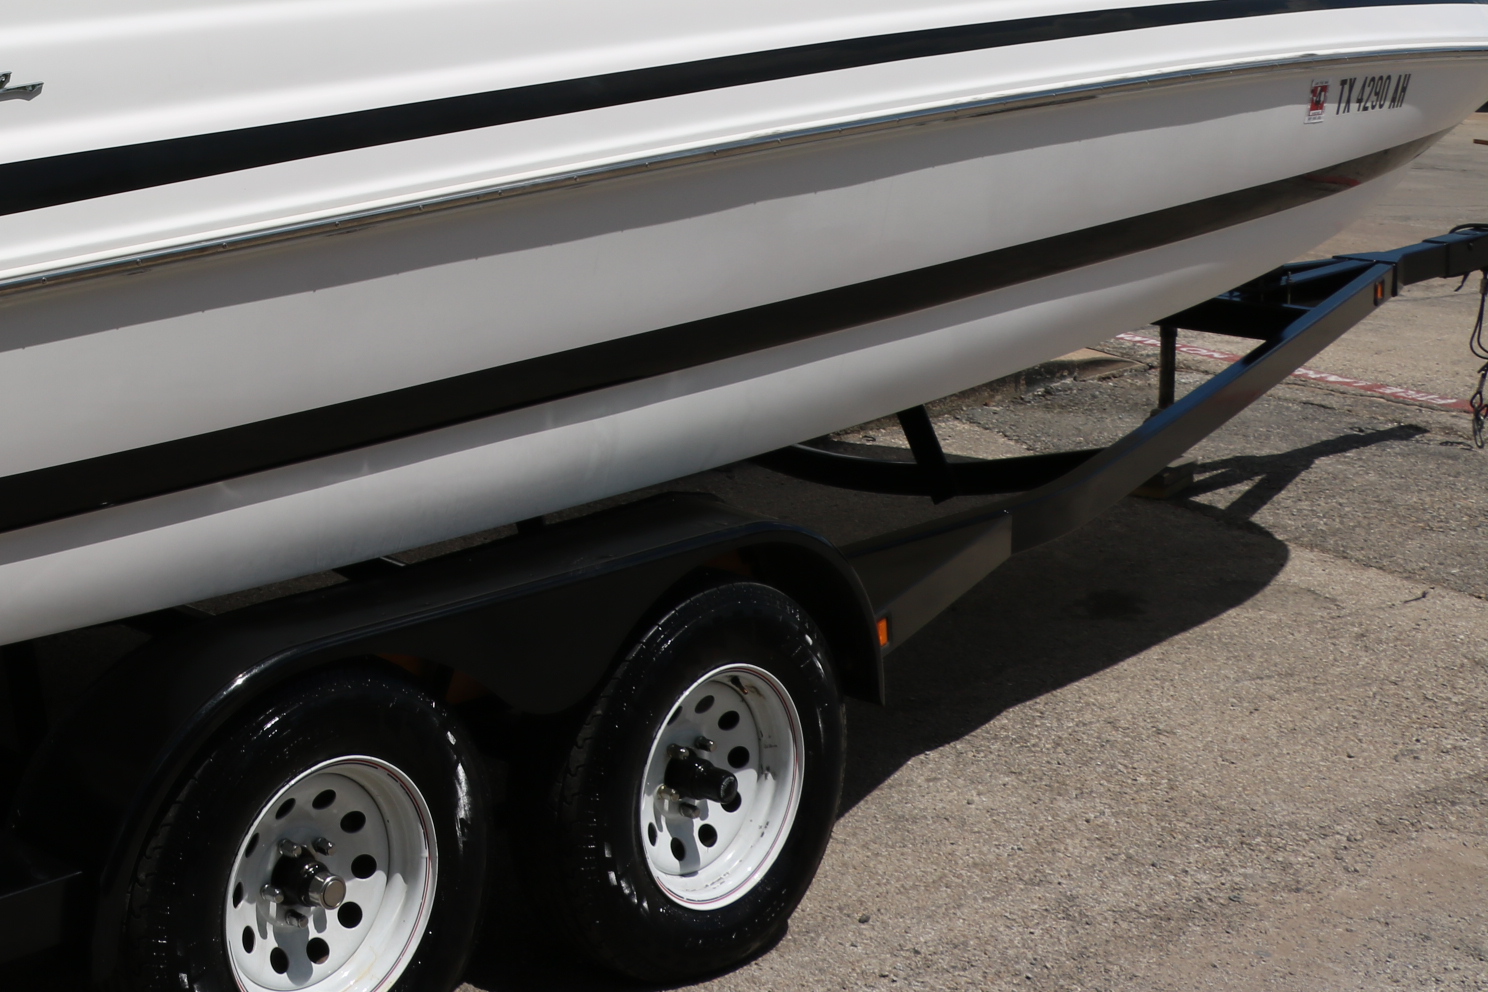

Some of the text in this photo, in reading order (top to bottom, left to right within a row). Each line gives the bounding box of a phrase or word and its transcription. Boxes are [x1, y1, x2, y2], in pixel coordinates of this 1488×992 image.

[1335, 73, 1411, 115] TX 4290 AH
[1292, 367, 1373, 386] LAN
